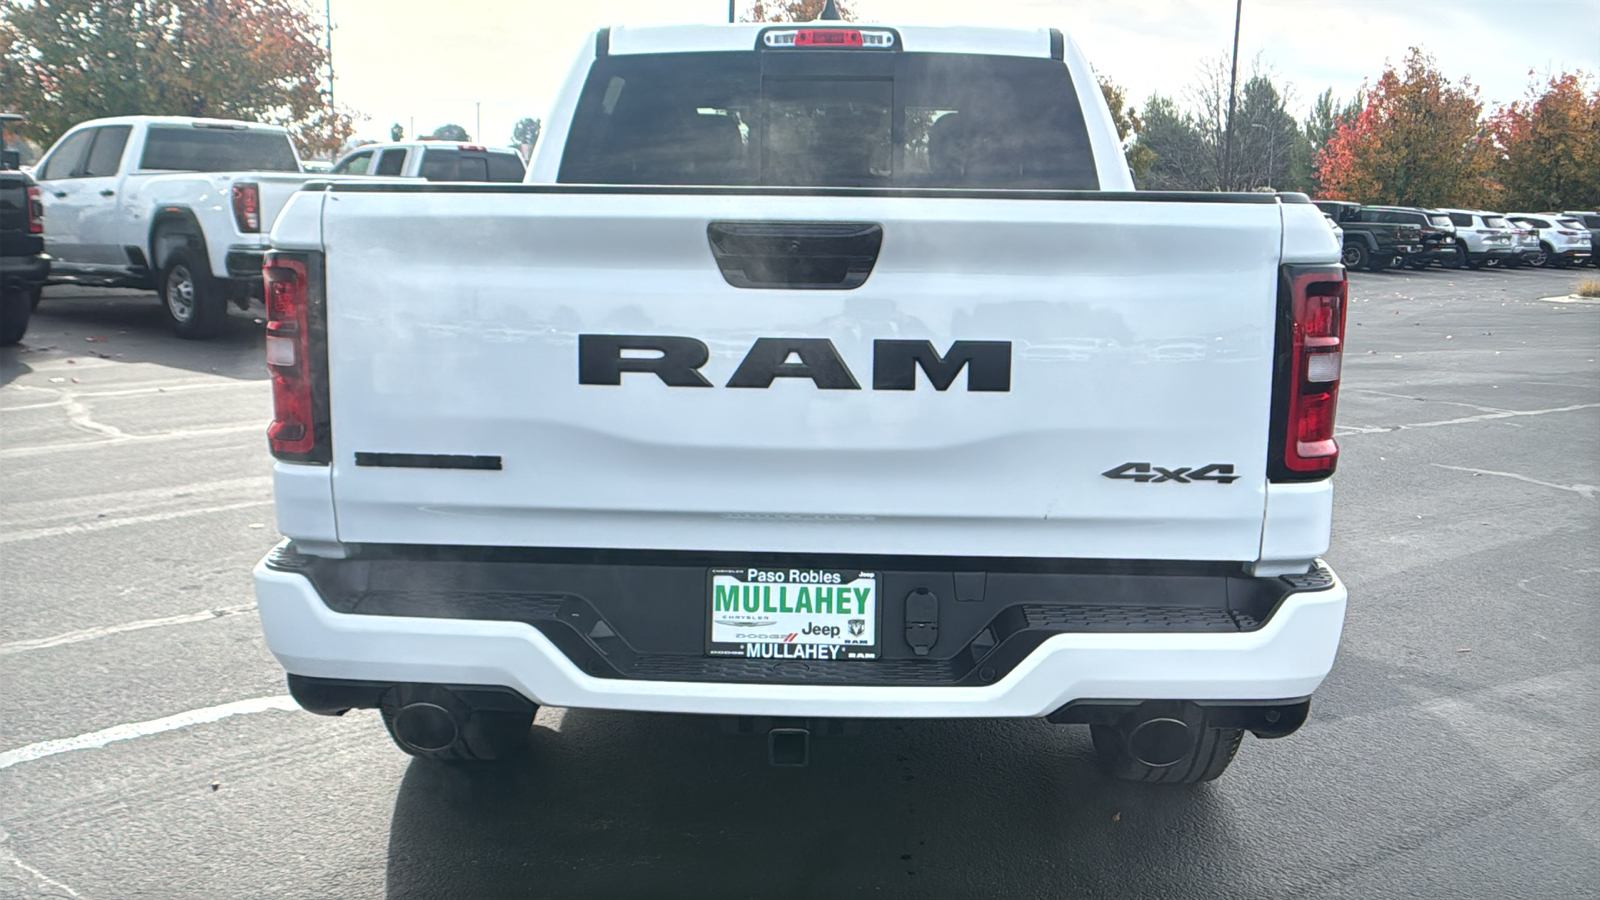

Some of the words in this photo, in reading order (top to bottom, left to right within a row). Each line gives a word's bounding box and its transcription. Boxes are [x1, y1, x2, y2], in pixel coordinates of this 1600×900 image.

[578, 333, 1013, 393] RAM
[1102, 461, 1241, 485] 4x4
[747, 568, 785, 582] Paso
[789, 569, 841, 584] Robles
[858, 571, 875, 579] Jeep
[715, 584, 871, 615] MULLAHEY
[802, 622, 841, 639] Jeep
[746, 643, 840, 660] MULLAHEY
